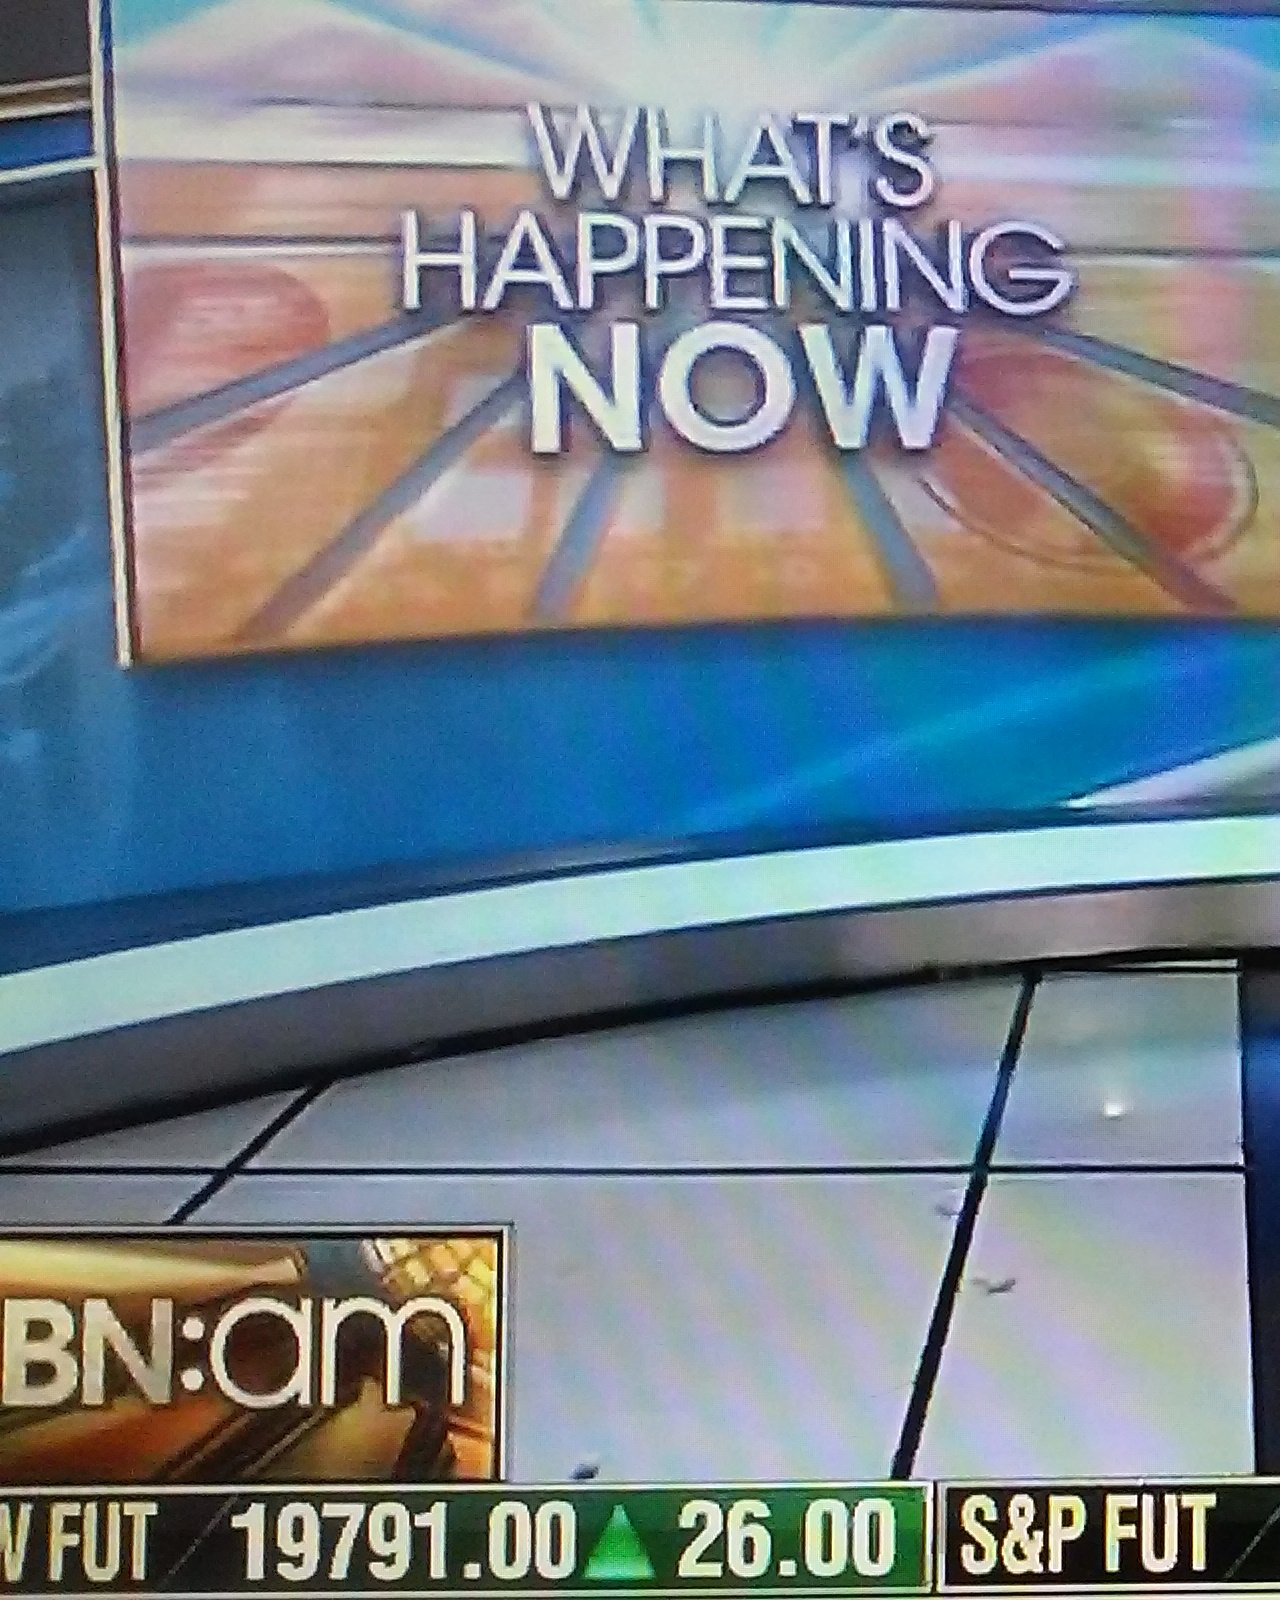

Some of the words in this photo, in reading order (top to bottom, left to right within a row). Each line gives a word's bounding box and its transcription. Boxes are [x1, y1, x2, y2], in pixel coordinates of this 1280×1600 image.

[526, 103, 935, 207] WHAT'S
[400, 209, 1073, 317] HAPPENING
[527, 322, 960, 454] NOW
[49, 1501, 158, 1582] FUT
[230, 1501, 578, 1582] 19791.00
[678, 1498, 896, 1580] 26.00
[959, 1493, 1086, 1574] S&P
[1104, 1493, 1217, 1572] FUT
